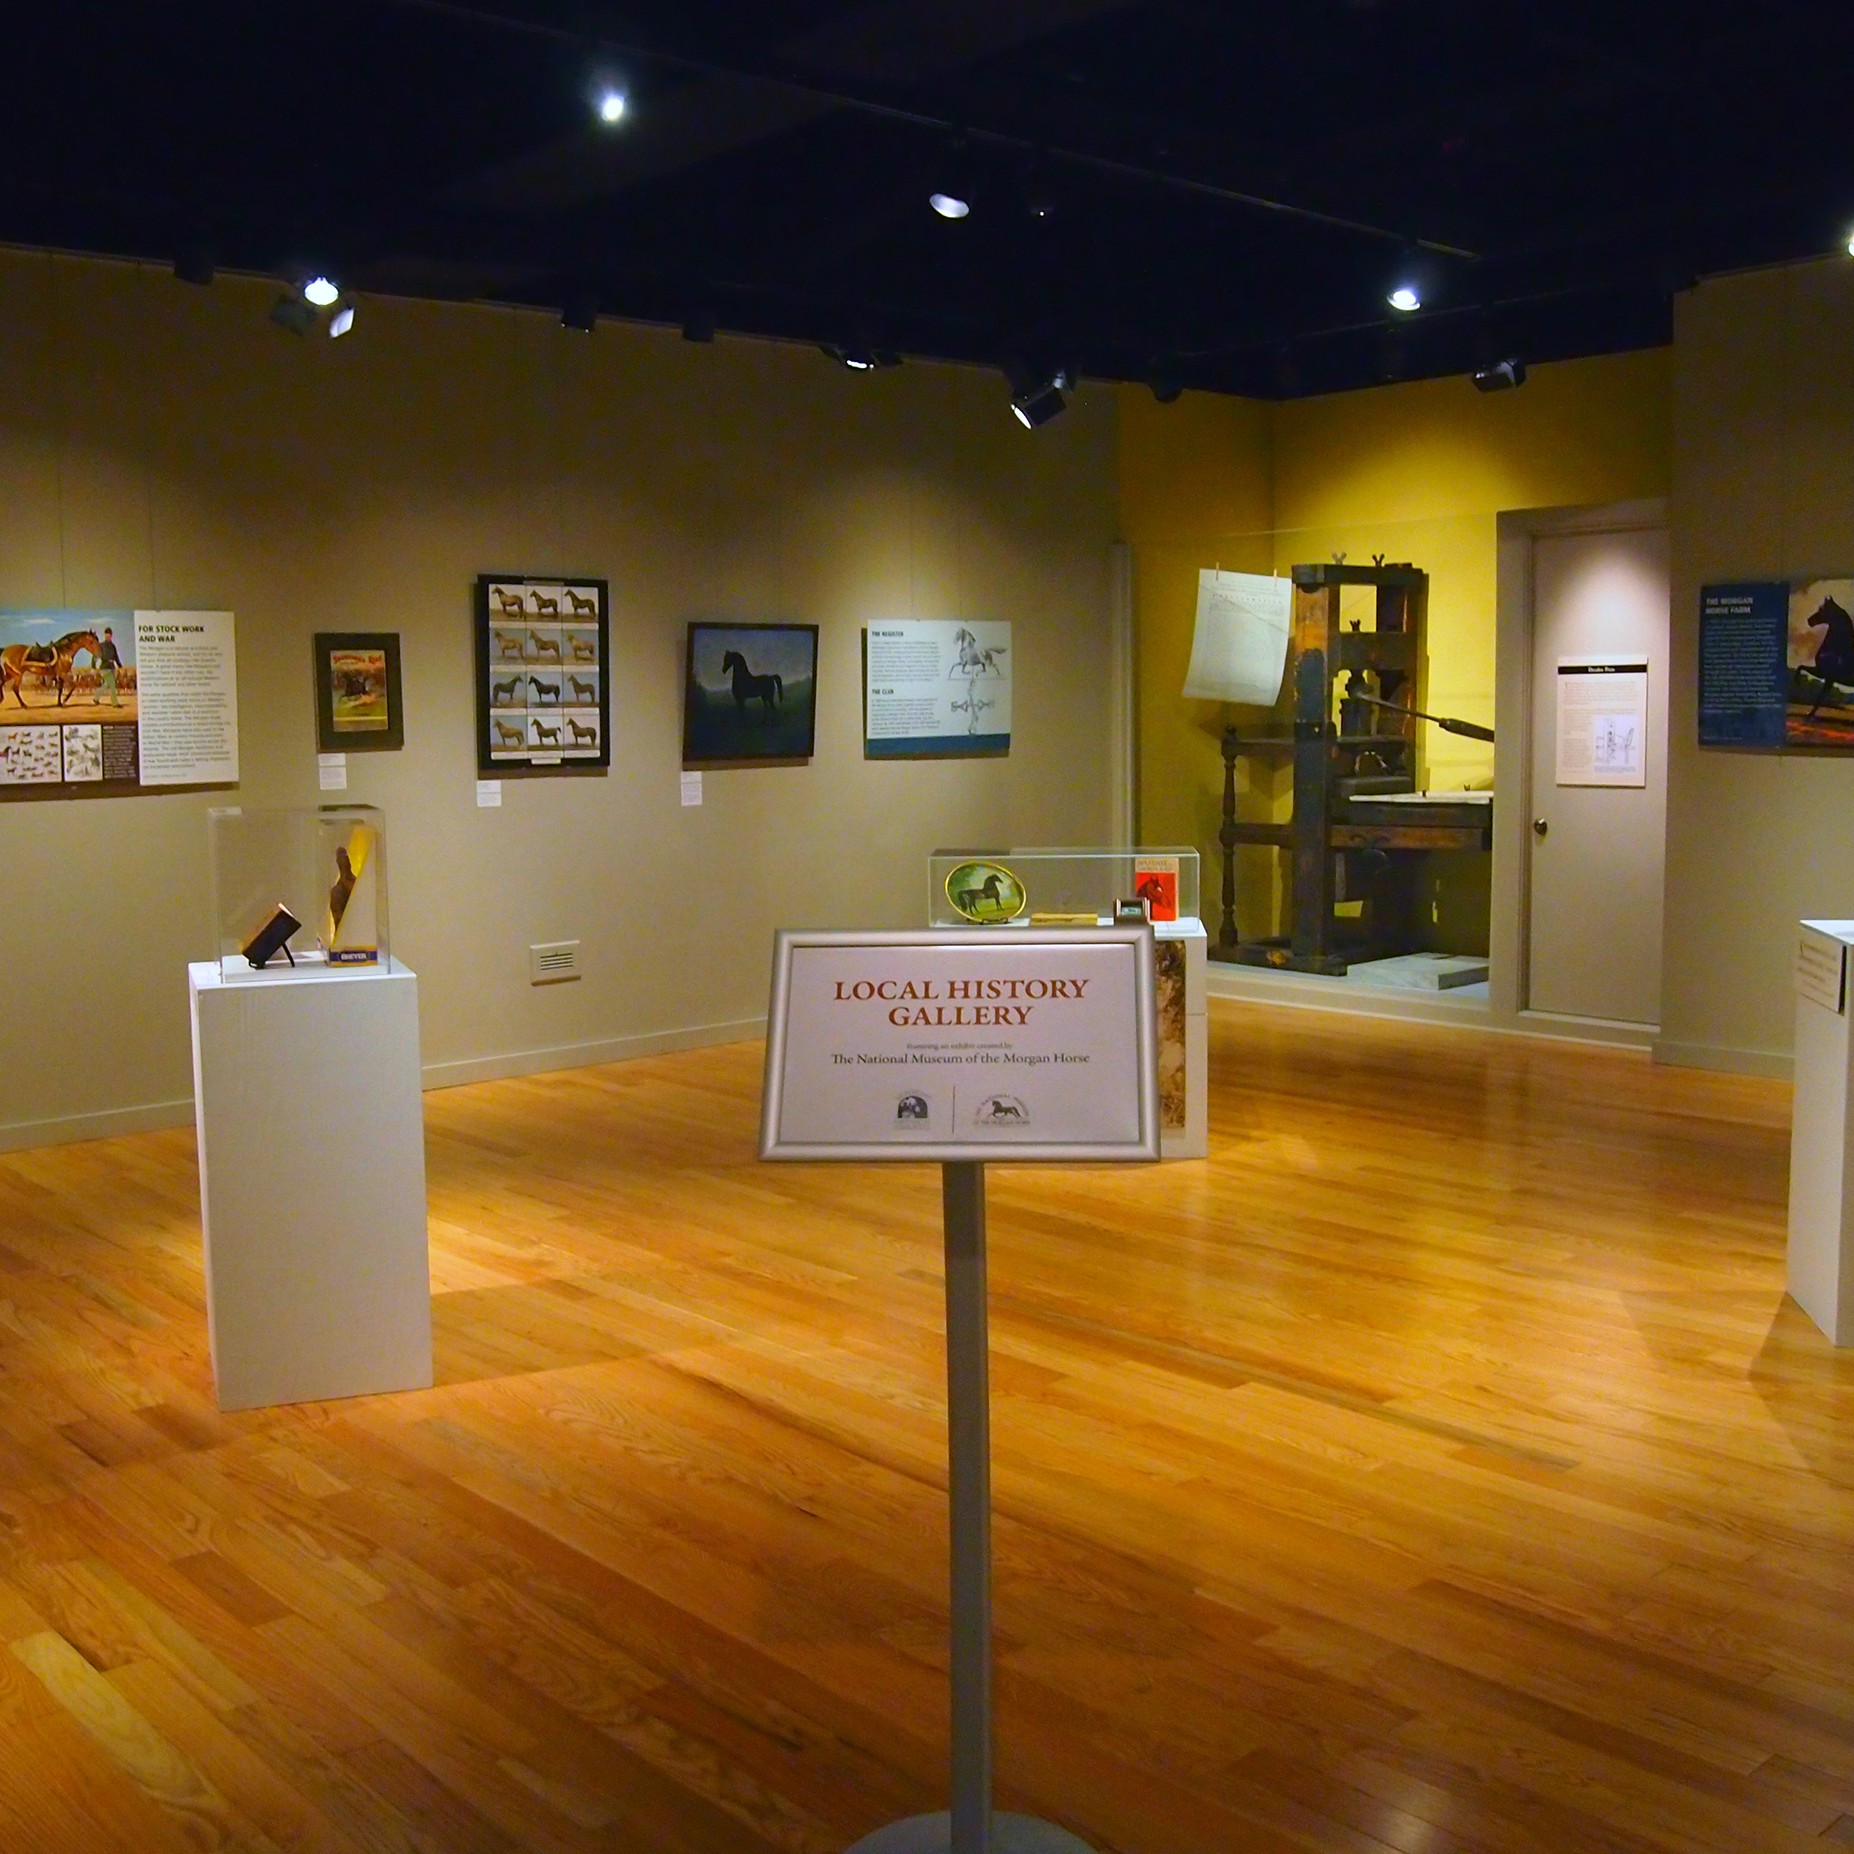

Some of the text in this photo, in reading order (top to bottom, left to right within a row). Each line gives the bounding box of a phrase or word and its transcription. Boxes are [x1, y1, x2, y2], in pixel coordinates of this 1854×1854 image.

[138, 625, 205, 633] FOR STOCK WORK
[139, 635, 176, 643] AND WAR
[833, 979, 1089, 1001] LOCAL HISTORY
[888, 1006, 1033, 1027] GALLERY
[831, 1053, 1090, 1066] The National Museum of the Morgan Horse
